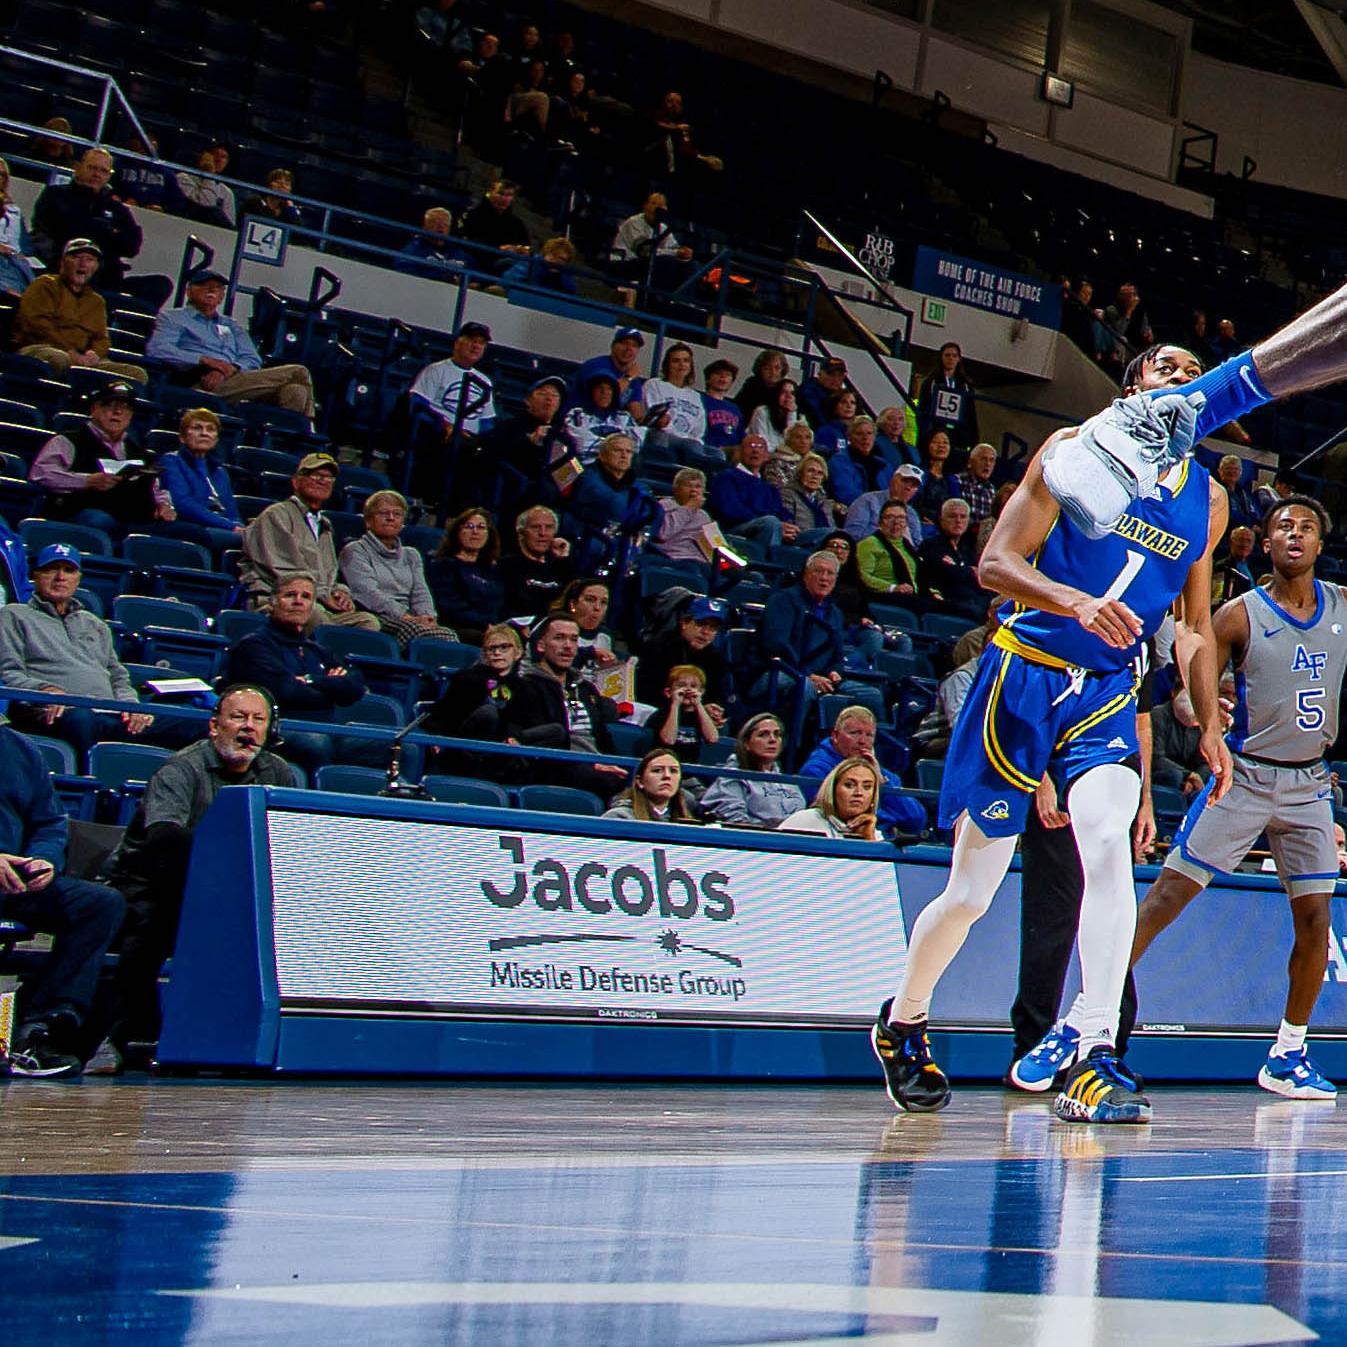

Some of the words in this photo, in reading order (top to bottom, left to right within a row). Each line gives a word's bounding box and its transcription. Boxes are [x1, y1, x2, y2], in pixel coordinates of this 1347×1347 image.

[247, 226, 276, 250] L4
[938, 259, 963, 279] HOME
[965, 267, 977, 284] OF
[980, 271, 995, 291] THE
[997, 276, 1012, 295] AIR
[1014, 281, 1042, 303] FORCE
[953, 282, 993, 308] COACHES
[997, 295, 1021, 315] SHOW
[937, 390, 962, 413] L5
[1112, 514, 1189, 561] LAWARE
[1103, 549, 1146, 602] 1
[1291, 644, 1327, 680] AF
[1296, 688, 1326, 733] 5
[480, 836, 735, 921] Jacobs
[490, 960, 574, 991] Missile
[580, 965, 673, 995] Defense
[679, 969, 746, 1002] Group
